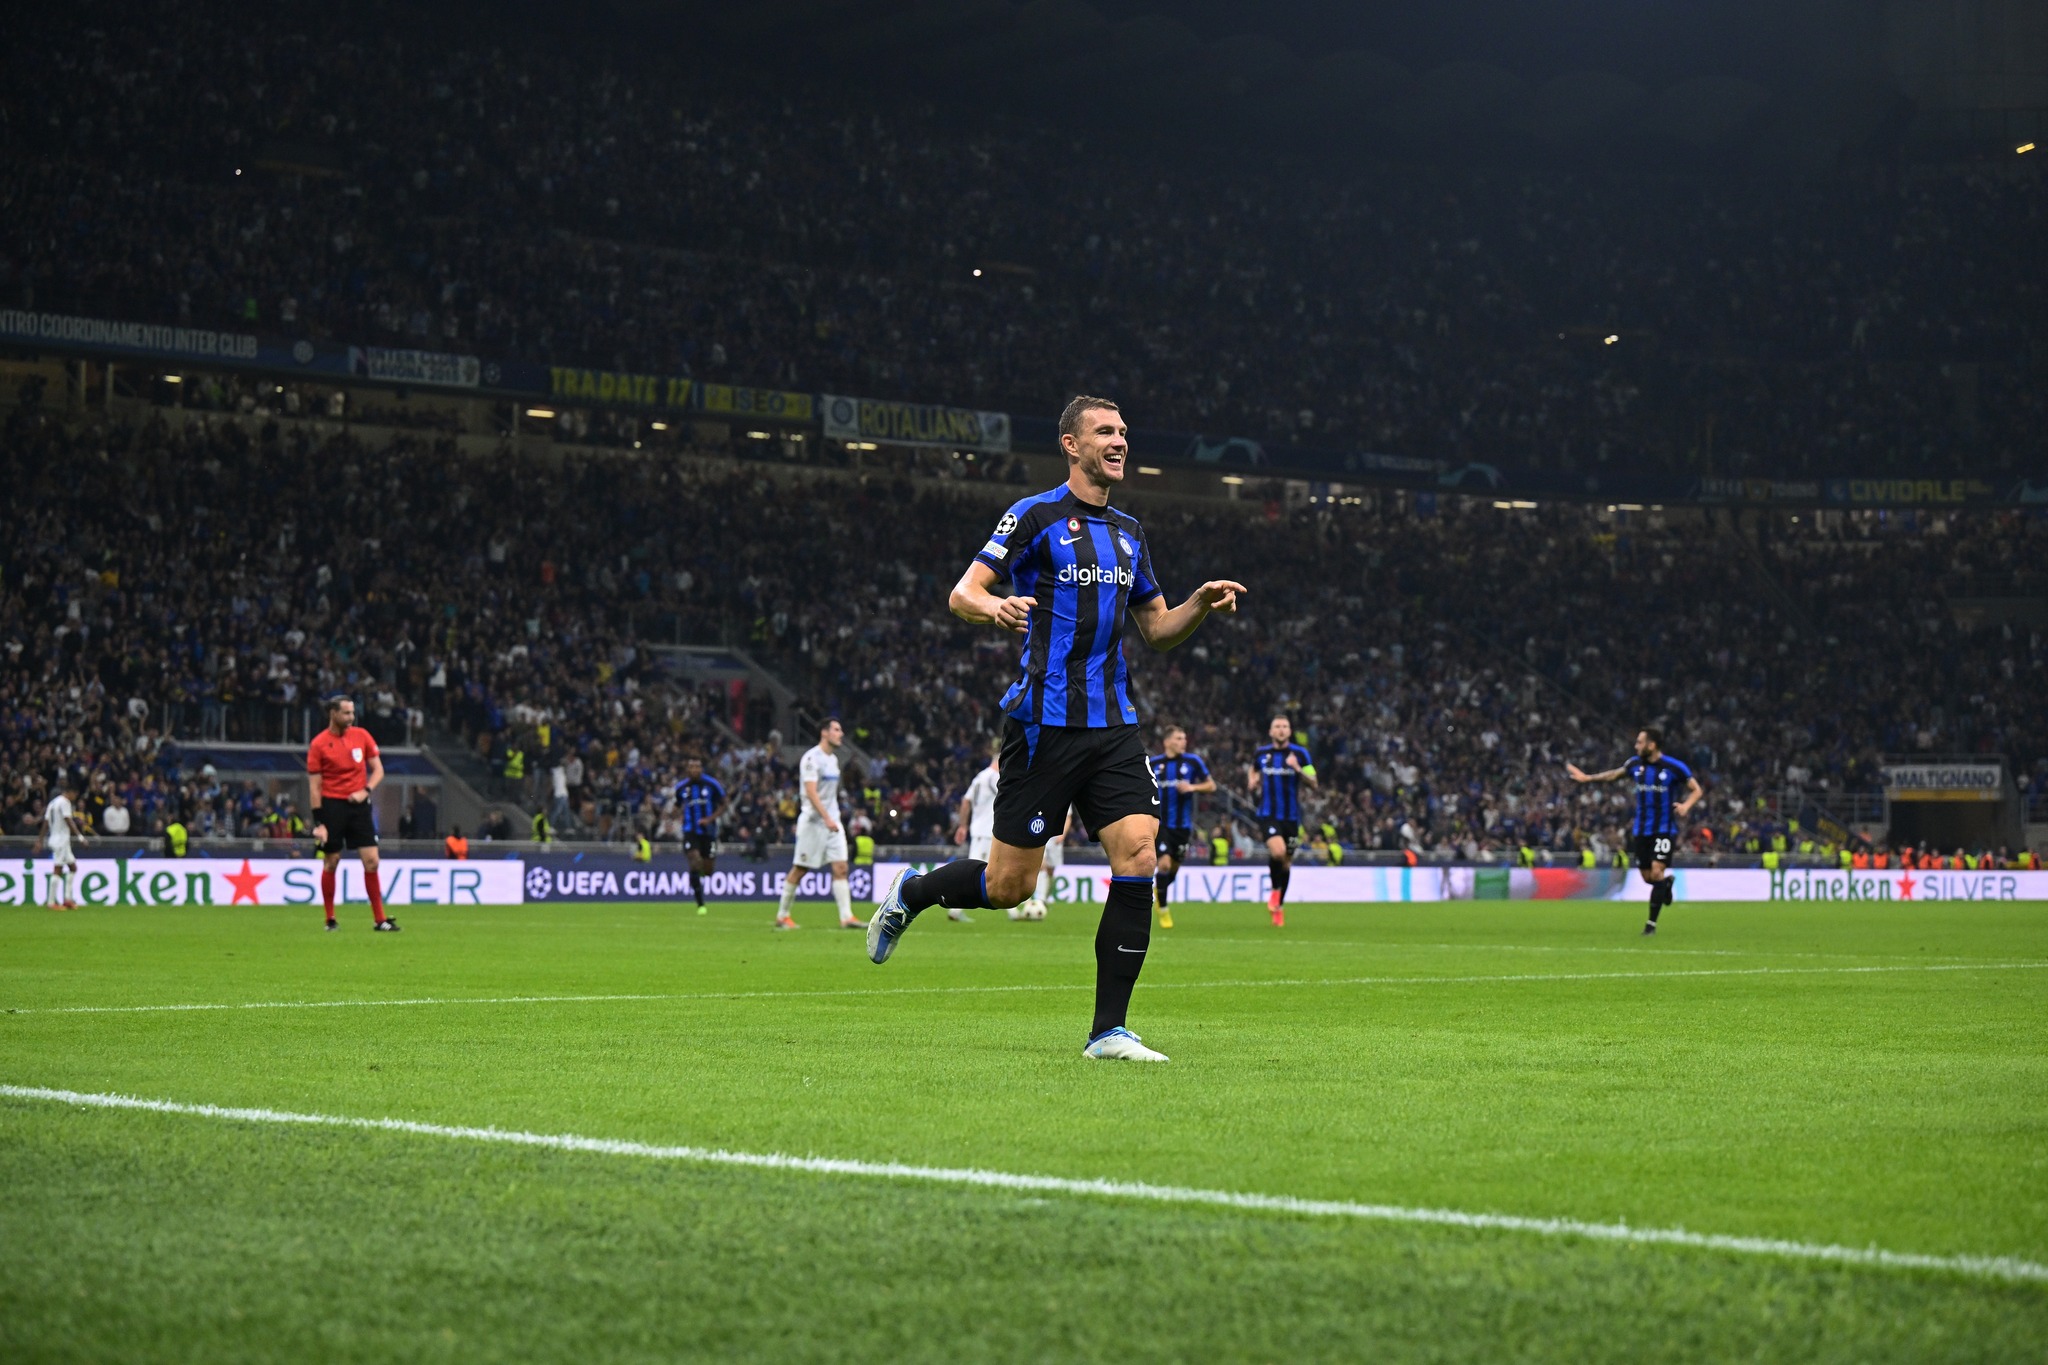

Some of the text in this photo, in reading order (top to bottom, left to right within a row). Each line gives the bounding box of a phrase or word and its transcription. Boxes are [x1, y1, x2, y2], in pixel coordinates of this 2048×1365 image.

[41, 312, 172, 351] COORDINAMENTO
[175, 326, 218, 355] INTER
[220, 331, 258, 359] CLUB
[732, 387, 786, 414] ISEO
[1654, 838, 1671, 853] 20
[557, 871, 832, 896] UEFA CHAMIONS LEGU
[1770, 868, 2017, 901] Heineken SILVER
